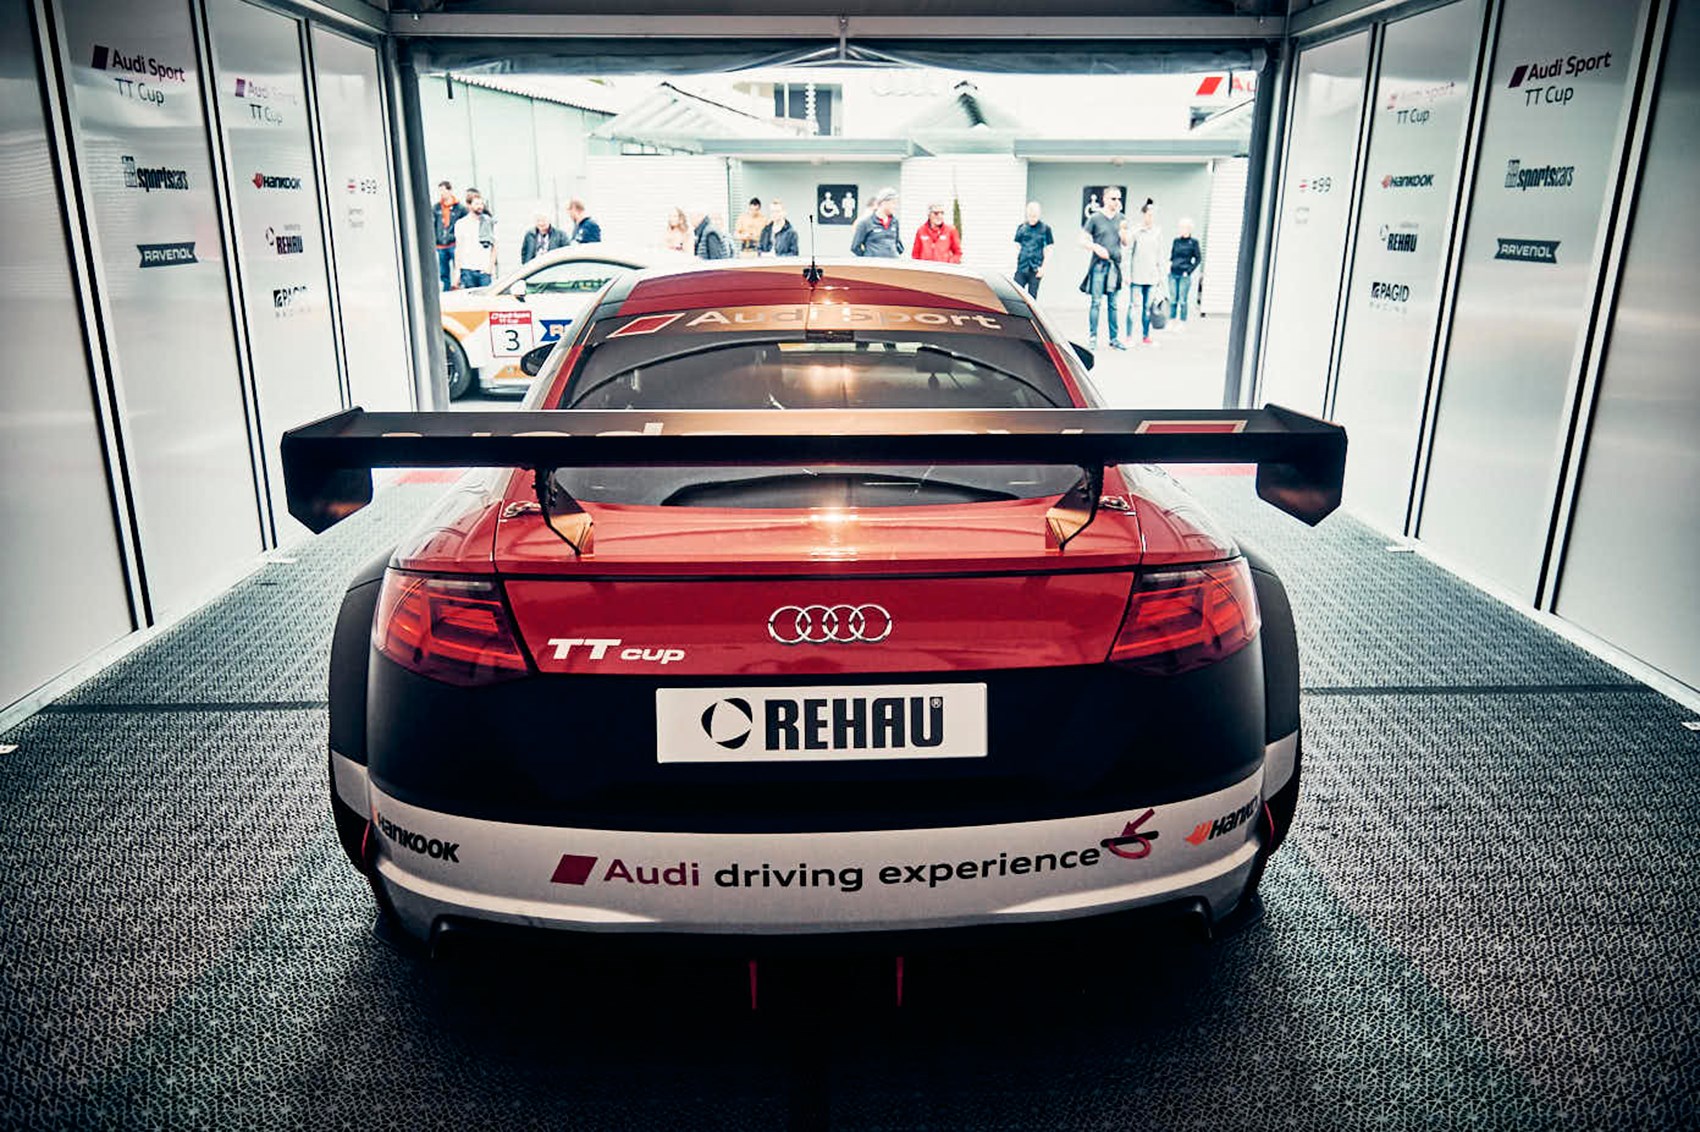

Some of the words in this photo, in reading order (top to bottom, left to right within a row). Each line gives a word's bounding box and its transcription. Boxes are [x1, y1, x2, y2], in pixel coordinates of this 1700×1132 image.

[112, 49, 147, 75] Audi
[148, 57, 186, 83] Sport
[1527, 58, 1563, 81] Audi
[1565, 51, 1612, 77] Sport
[114, 78, 134, 98] TT
[138, 82, 164, 107] Cup
[1525, 87, 1543, 107] TT
[1545, 85, 1574, 106] Cup
[1397, 109, 1409, 124] TT
[1410, 108, 1430, 125] Cup
[1387, 233, 1418, 252] REHAU
[1499, 243, 1554, 259] RAVENOL
[144, 247, 193, 262] RAVENOL
[1380, 283, 1410, 302] PAGID
[841, 304, 1001, 330] Sport
[505, 329, 520, 351] 3
[547, 638, 622, 660] TT
[603, 858, 701, 887] Audi
[714, 862, 863, 892] driving
[878, 846, 1101, 887] experience
